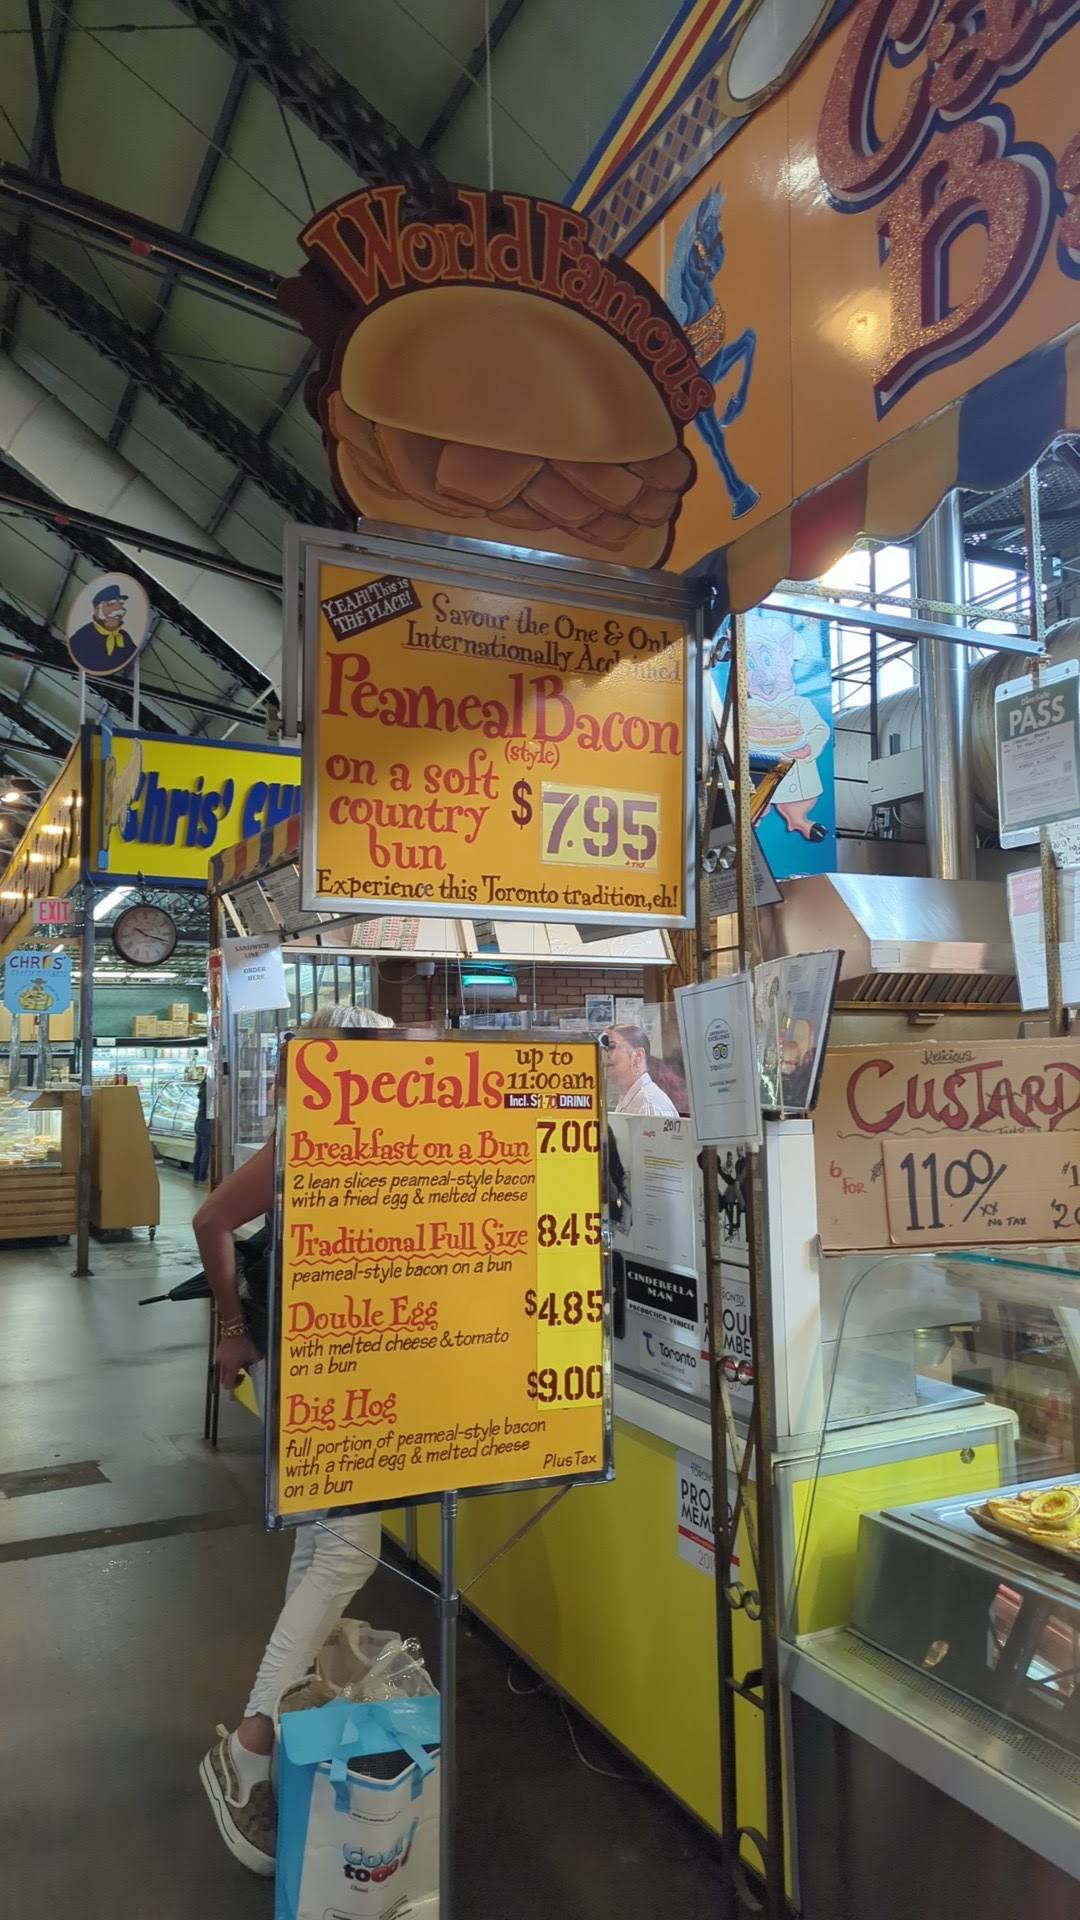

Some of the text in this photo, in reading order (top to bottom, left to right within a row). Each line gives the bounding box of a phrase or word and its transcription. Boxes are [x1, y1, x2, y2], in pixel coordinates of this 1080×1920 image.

[302, 186, 716, 421] World Famous
[322, 577, 409, 619] YEAH! This is
[334, 590, 413, 633] THE PLACE!
[432, 592, 682, 657] Savour the One & Onl
[405, 619, 575, 673] Internationally
[322, 652, 684, 756] Peameal Bacon
[1009, 695, 1065, 737] PASS
[505, 739, 560, 770] (style)
[325, 748, 500, 800] on a soft
[329, 795, 491, 844] country
[367, 824, 447, 871] bun
[316, 868, 434, 899] Experience
[437, 874, 478, 901] this
[482, 875, 558, 904] Toronto
[39, 902, 69, 923] EXIT
[243, 966, 266, 974] ORDER
[244, 951, 259, 959] LINE
[295, 1039, 573, 1125] Specials up to
[510, 1094, 530, 1107] Incl.
[560, 1095, 591, 1107] DRINK
[536, 1120, 600, 1153] 7.00
[664, 1120, 681, 1132] 2017
[290, 1128, 529, 1162] Breakfast on a Bun
[293, 1169, 536, 1195] 2 lean slices peameal-style bacon
[829, 1160, 842, 1178] 6
[291, 1186, 528, 1210] with a fried egg & melted cheese
[290, 1217, 529, 1257] Traditional Full Size
[537, 1212, 601, 1247] 8.45
[1006, 1216, 1027, 1226] TAX
[291, 1256, 513, 1290] peameal-style bacon on a bun
[627, 1271, 696, 1298] CINDERELLA
[524, 1288, 602, 1327] $4.85
[648, 1287, 674, 1302] MAN
[288, 1295, 438, 1333] Double Egg
[629, 1303, 695, 1331] PRODUCTION VEHICLE
[290, 1340, 323, 1358] with
[328, 1335, 382, 1355] melted
[385, 1334, 437, 1352] cheese
[658, 1342, 697, 1368] Toronto
[290, 1357, 357, 1377] on a bun
[527, 1365, 603, 1403] $9.00
[285, 1388, 398, 1431] Big Hog
[286, 1416, 547, 1461] full portion of peameal-style bacon
[286, 1438, 530, 1478] with a fried egg & melted cheese
[284, 1476, 353, 1498] on a bun
